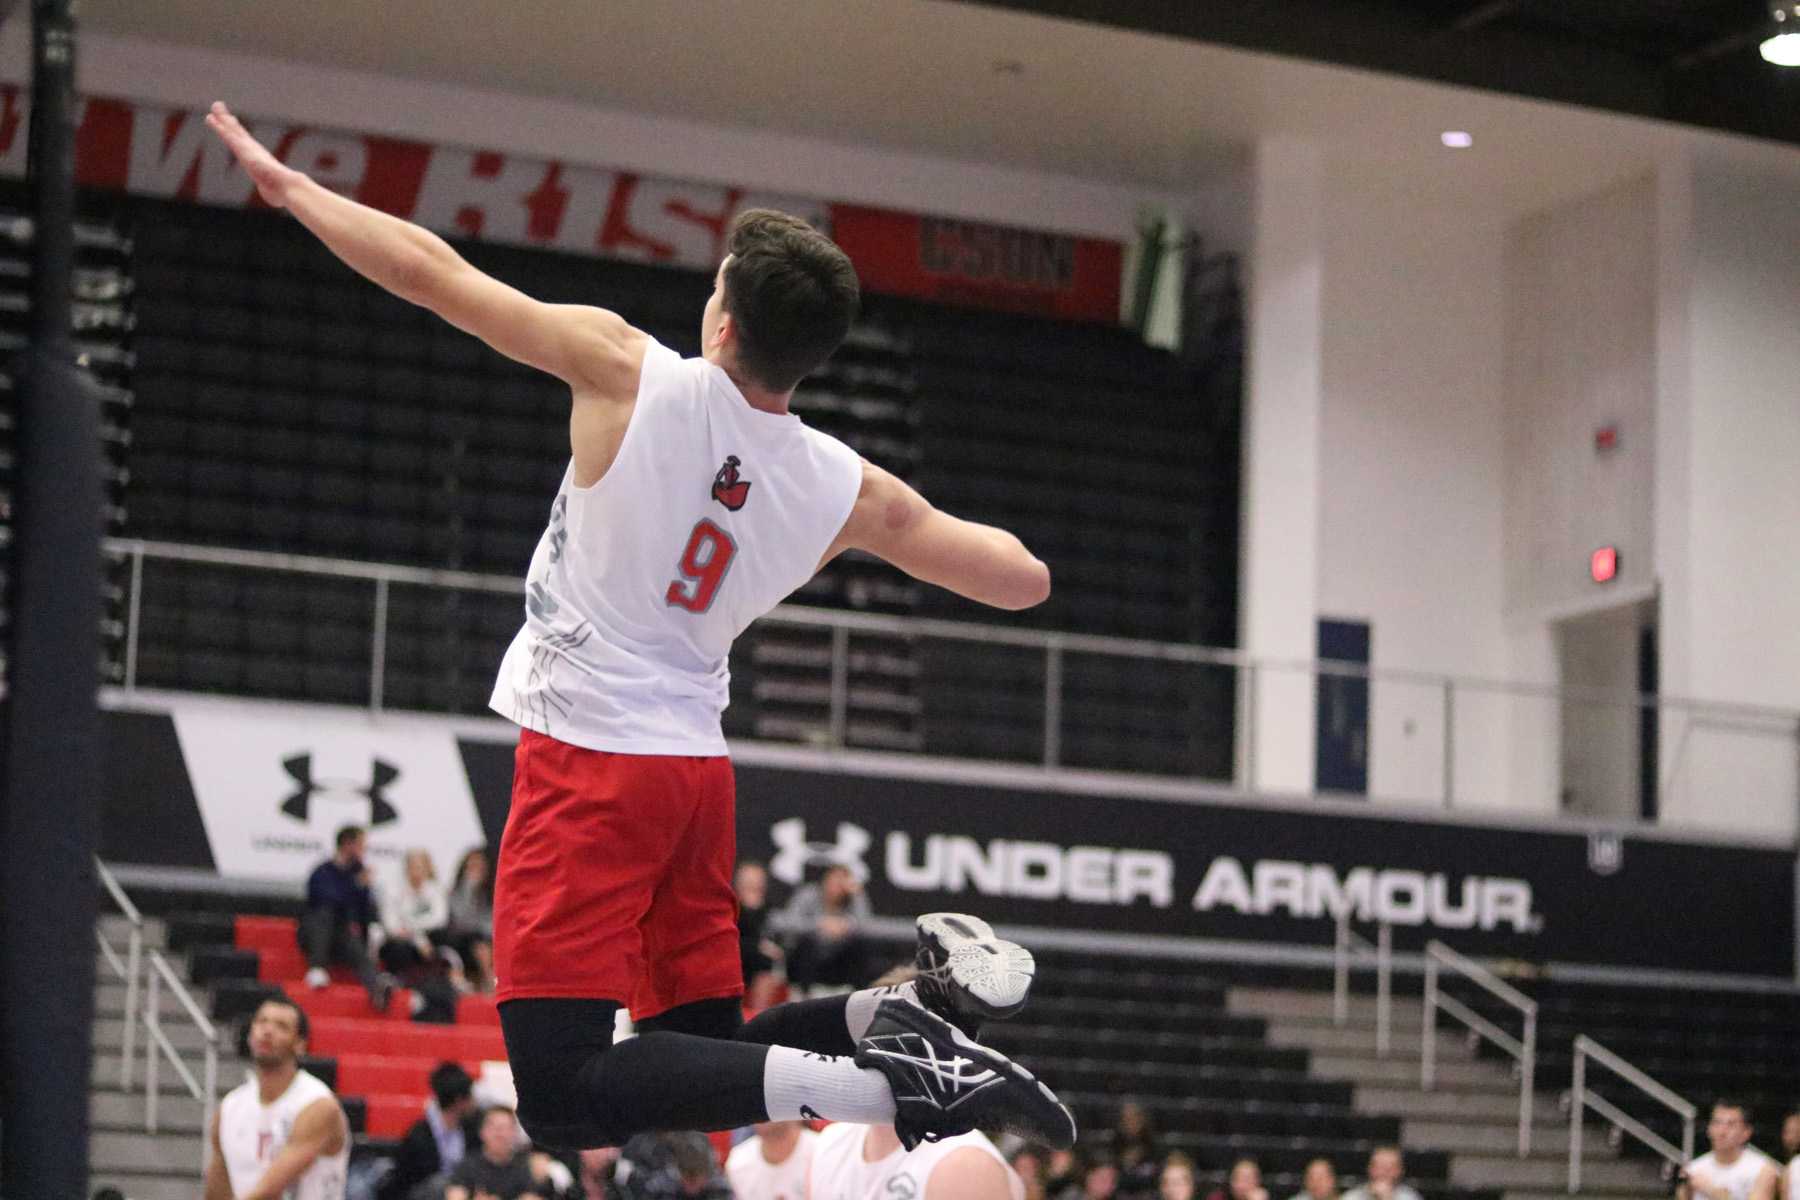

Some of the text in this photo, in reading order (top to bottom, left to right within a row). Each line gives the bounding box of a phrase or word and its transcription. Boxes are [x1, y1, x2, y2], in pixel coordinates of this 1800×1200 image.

[127, 109, 367, 206] We
[665, 516, 739, 615] 9
[885, 829, 1534, 934] UNDER ARMOUR
